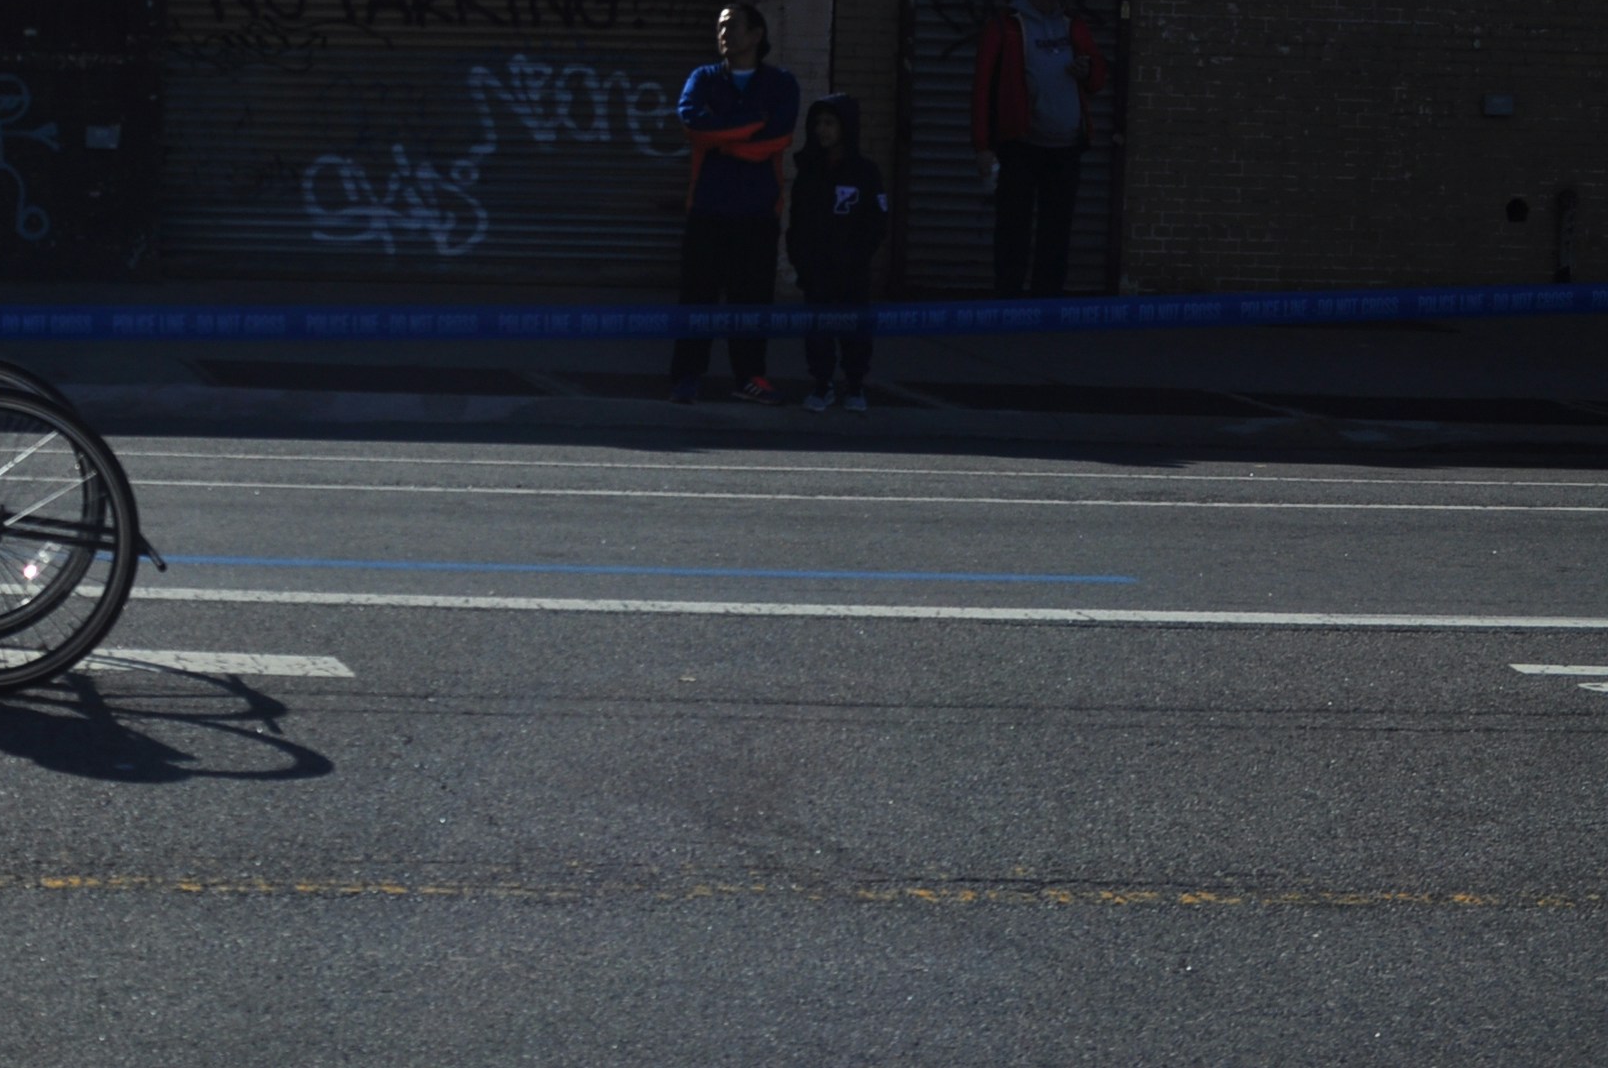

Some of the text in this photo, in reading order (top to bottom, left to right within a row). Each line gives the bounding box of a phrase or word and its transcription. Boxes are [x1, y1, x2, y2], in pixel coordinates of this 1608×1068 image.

[1061, 301, 1221, 324] POLICE LINE DO NOT CROSS
[1241, 296, 1399, 319] POLICE LINE DO NOT CROSS
[1417, 295, 1457, 314] POLICE
[1460, 293, 1485, 312] LINE
[1493, 293, 1509, 310] DO
[1512, 292, 1533, 309] NOT
[1537, 291, 1574, 309] CROSS
[689, 312, 859, 332] POLICE LINE DO NOT CROSS
[878, 307, 1042, 330] POLICE LINE DO NOT CROSS
